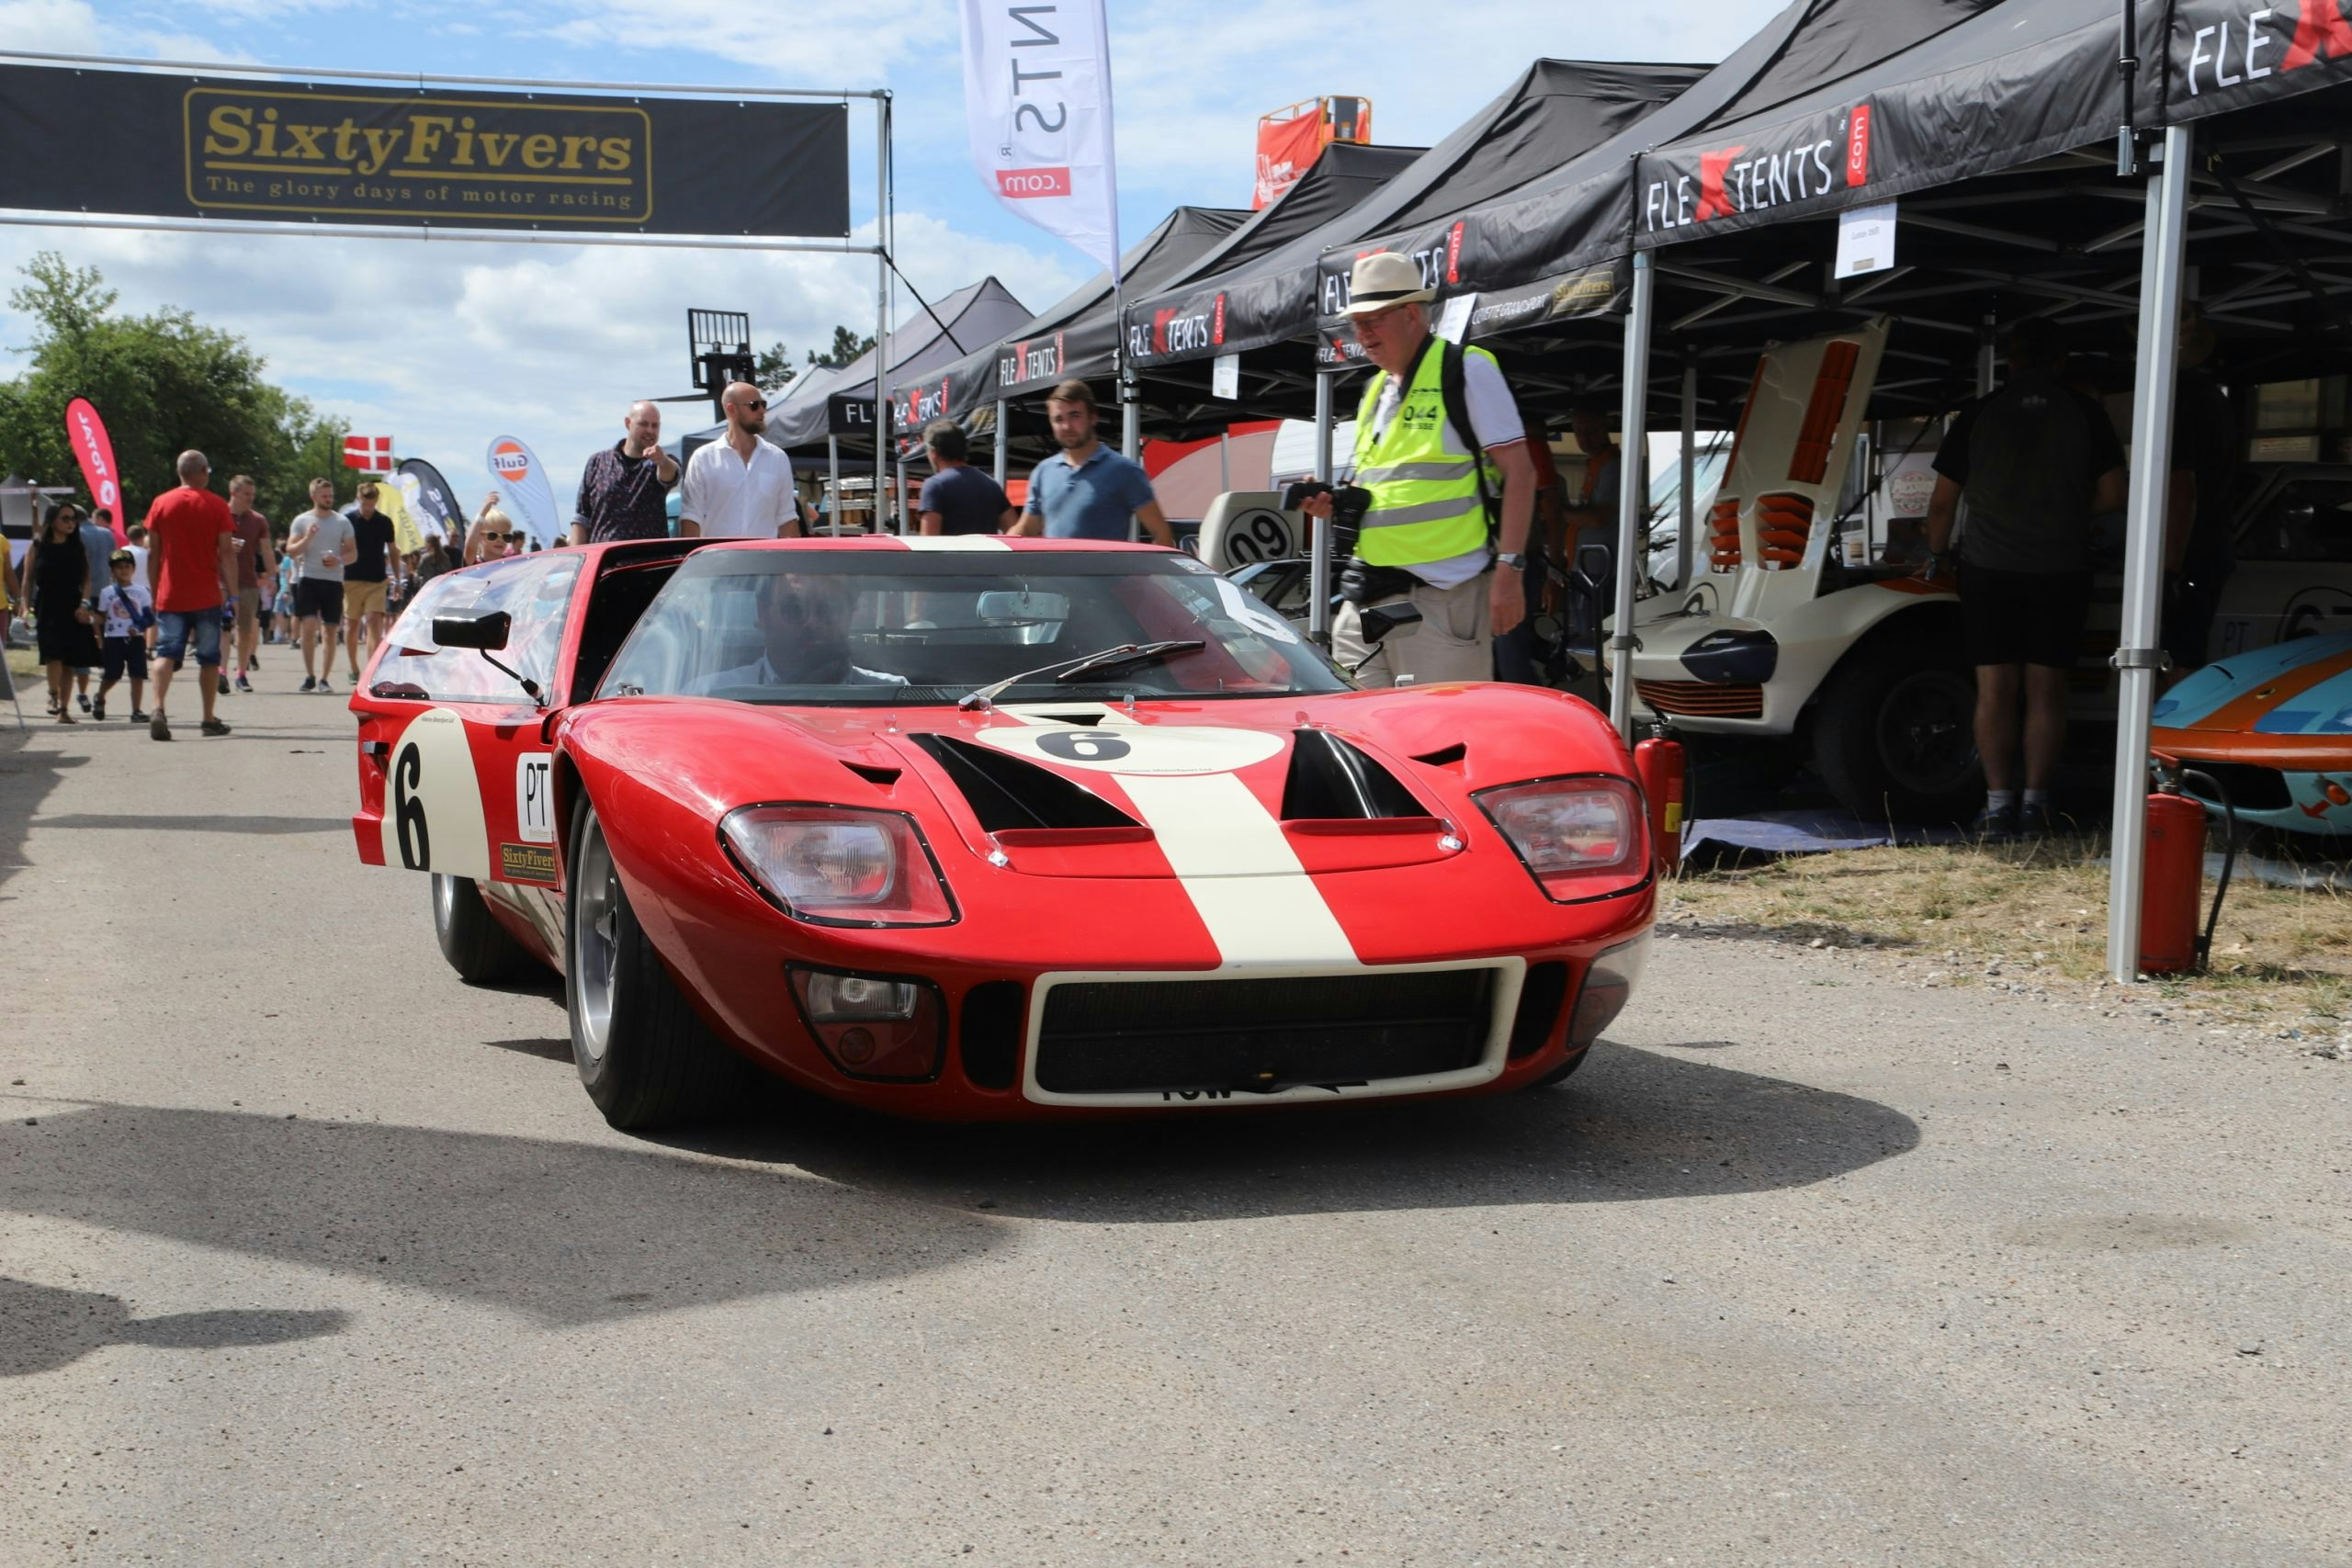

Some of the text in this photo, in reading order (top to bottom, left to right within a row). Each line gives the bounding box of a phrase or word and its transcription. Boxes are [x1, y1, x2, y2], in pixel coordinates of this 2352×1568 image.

[204, 106, 632, 175] SixtyFivers
[1849, 116, 1866, 176] .com
[206, 176, 633, 210] The glory days of motor racing
[845, 403, 876, 423] FL
[1035, 730, 1131, 761] 6
[394, 741, 431, 872] 6
[526, 761, 549, 828] PT
